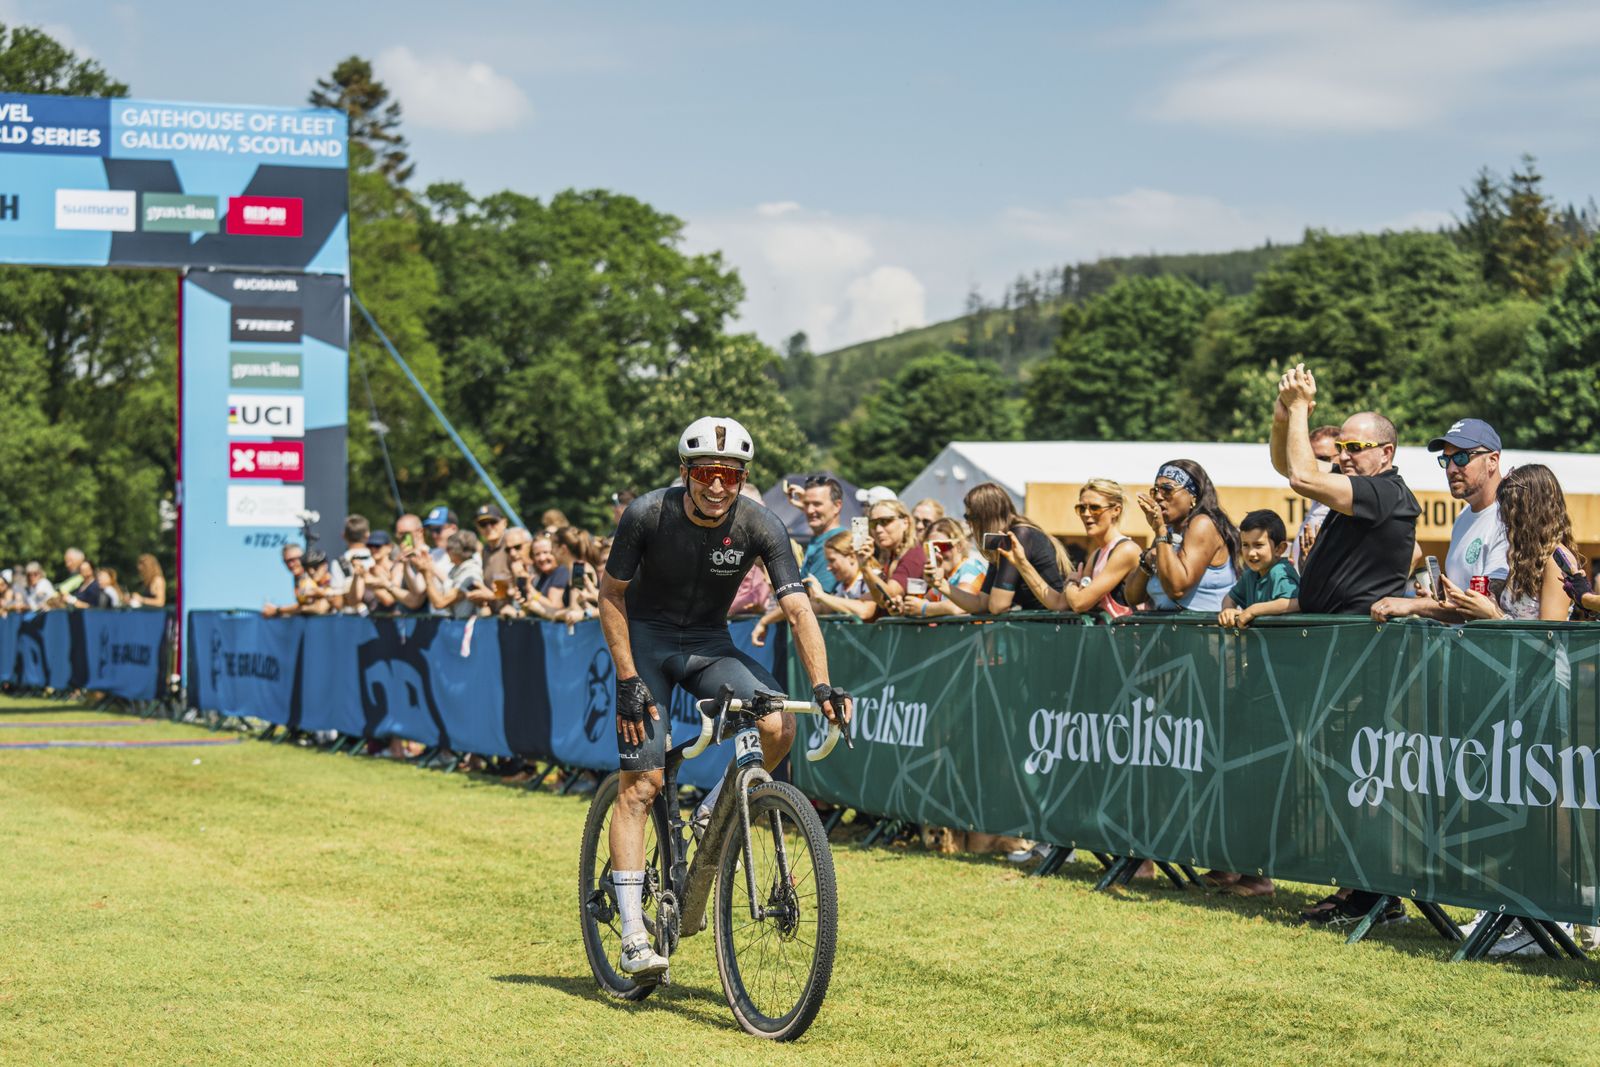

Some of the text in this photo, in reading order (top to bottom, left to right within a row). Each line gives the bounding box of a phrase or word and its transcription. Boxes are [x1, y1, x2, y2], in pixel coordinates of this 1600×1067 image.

[121, 108, 335, 135] GATEHOUSE OF FLEET
[0, 125, 101, 147] LD SERIES
[121, 130, 342, 157] GALLOWAY, SCOTLAND
[236, 318, 295, 332] TREK
[241, 406, 292, 425] UCI
[808, 685, 928, 748] gvelism
[741, 735, 761, 750] 12
[1024, 697, 1204, 775] gravelism
[1348, 720, 1600, 809] gravelism
